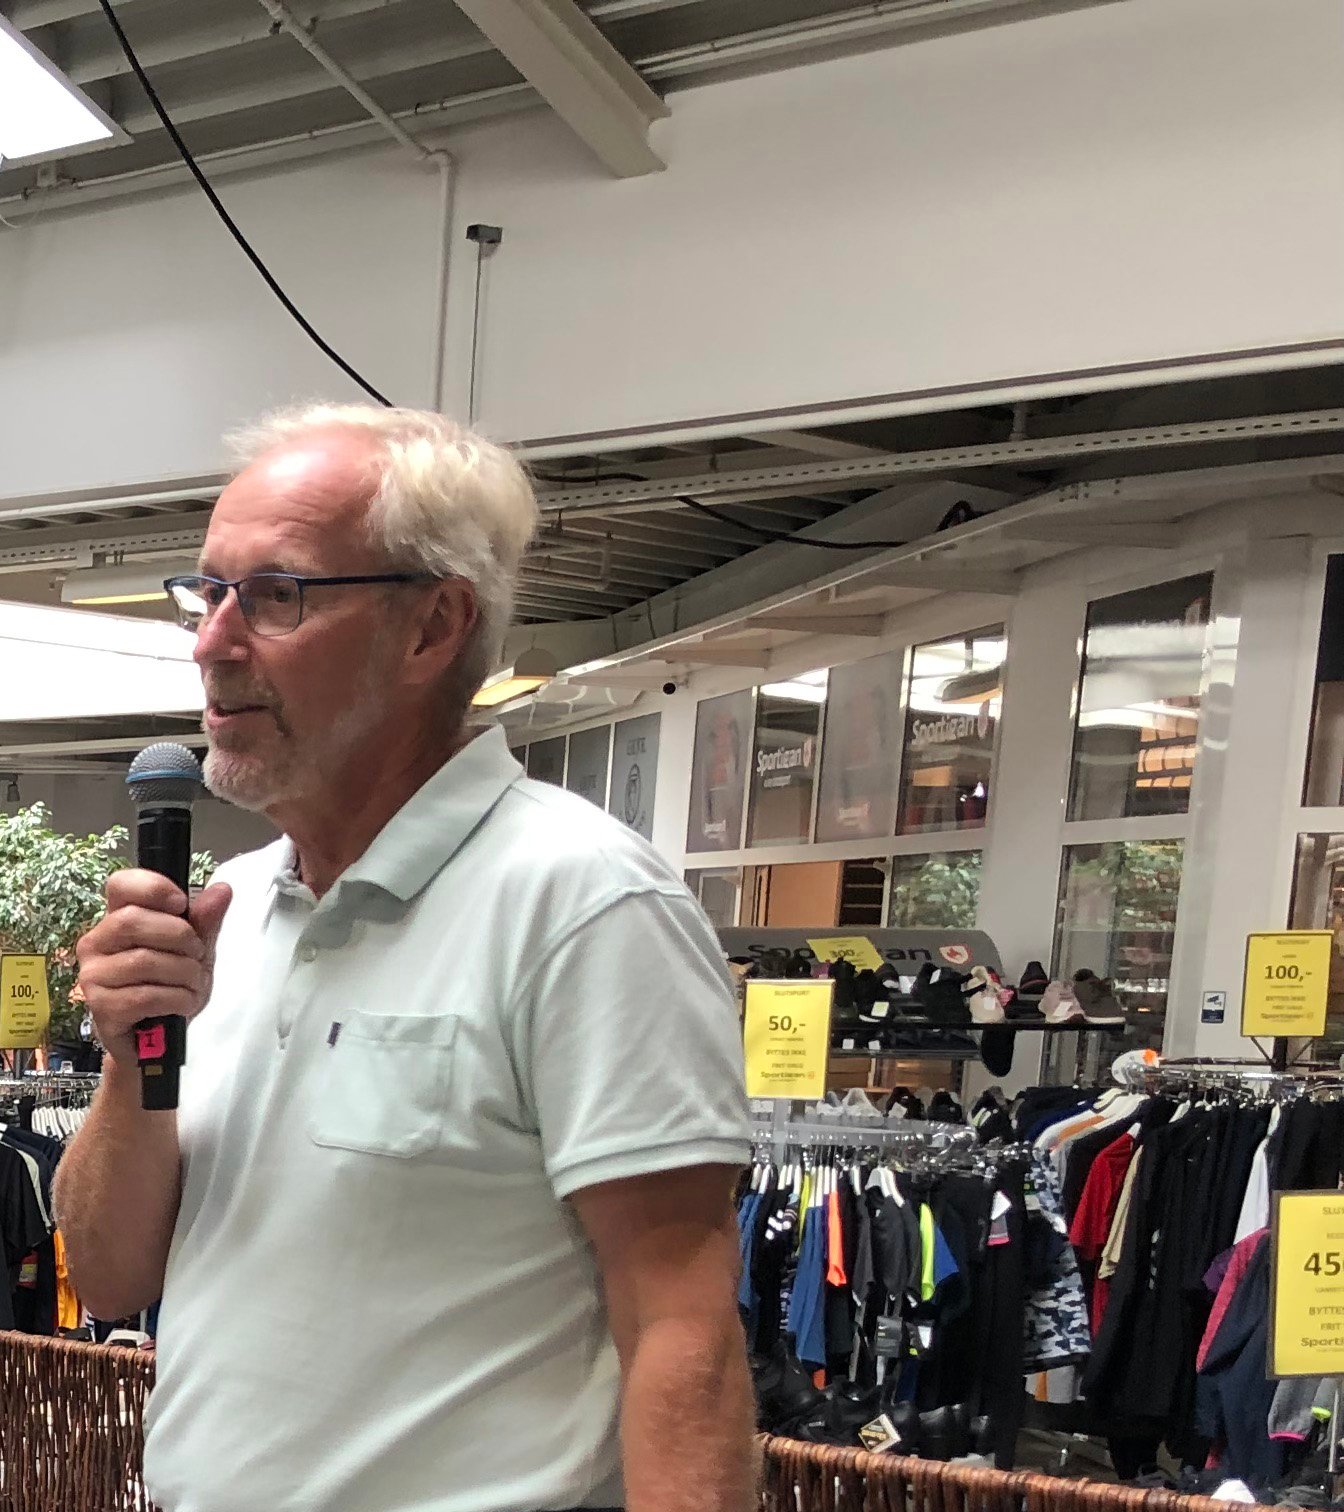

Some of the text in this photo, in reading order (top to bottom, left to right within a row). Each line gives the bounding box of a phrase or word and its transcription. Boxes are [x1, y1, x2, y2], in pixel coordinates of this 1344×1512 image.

[757, 748, 802, 777] Sportigan
[1265, 965, 1312, 982] 100,-
[10, 984, 39, 1000] 100,-
[768, 1015, 806, 1034] 50,-
[1303, 1251, 1344, 1277] 45
[1309, 1306, 1344, 1316] BYTTE
